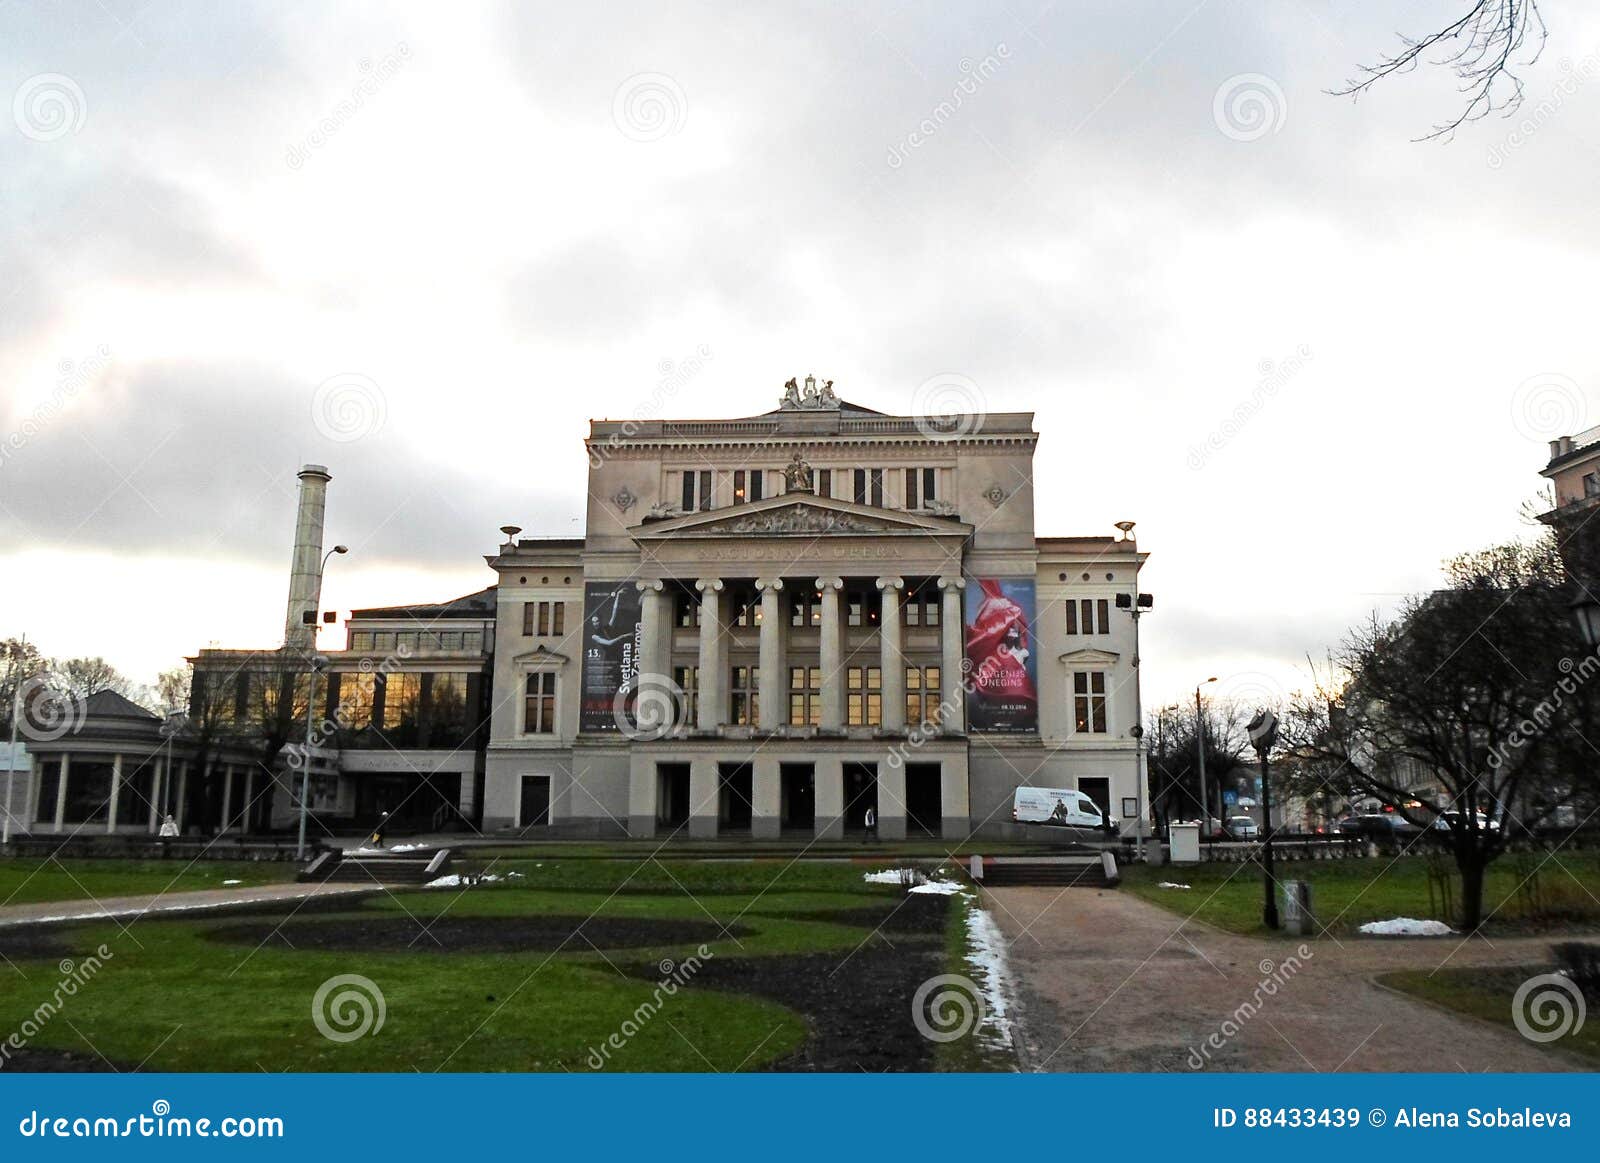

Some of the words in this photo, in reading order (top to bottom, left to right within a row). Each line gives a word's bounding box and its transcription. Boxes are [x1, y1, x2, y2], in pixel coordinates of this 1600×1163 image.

[619, 643, 632, 694] Svetlana
[631, 622, 642, 677] Zaharova
[979, 678, 1023, 687] ONEGINS
